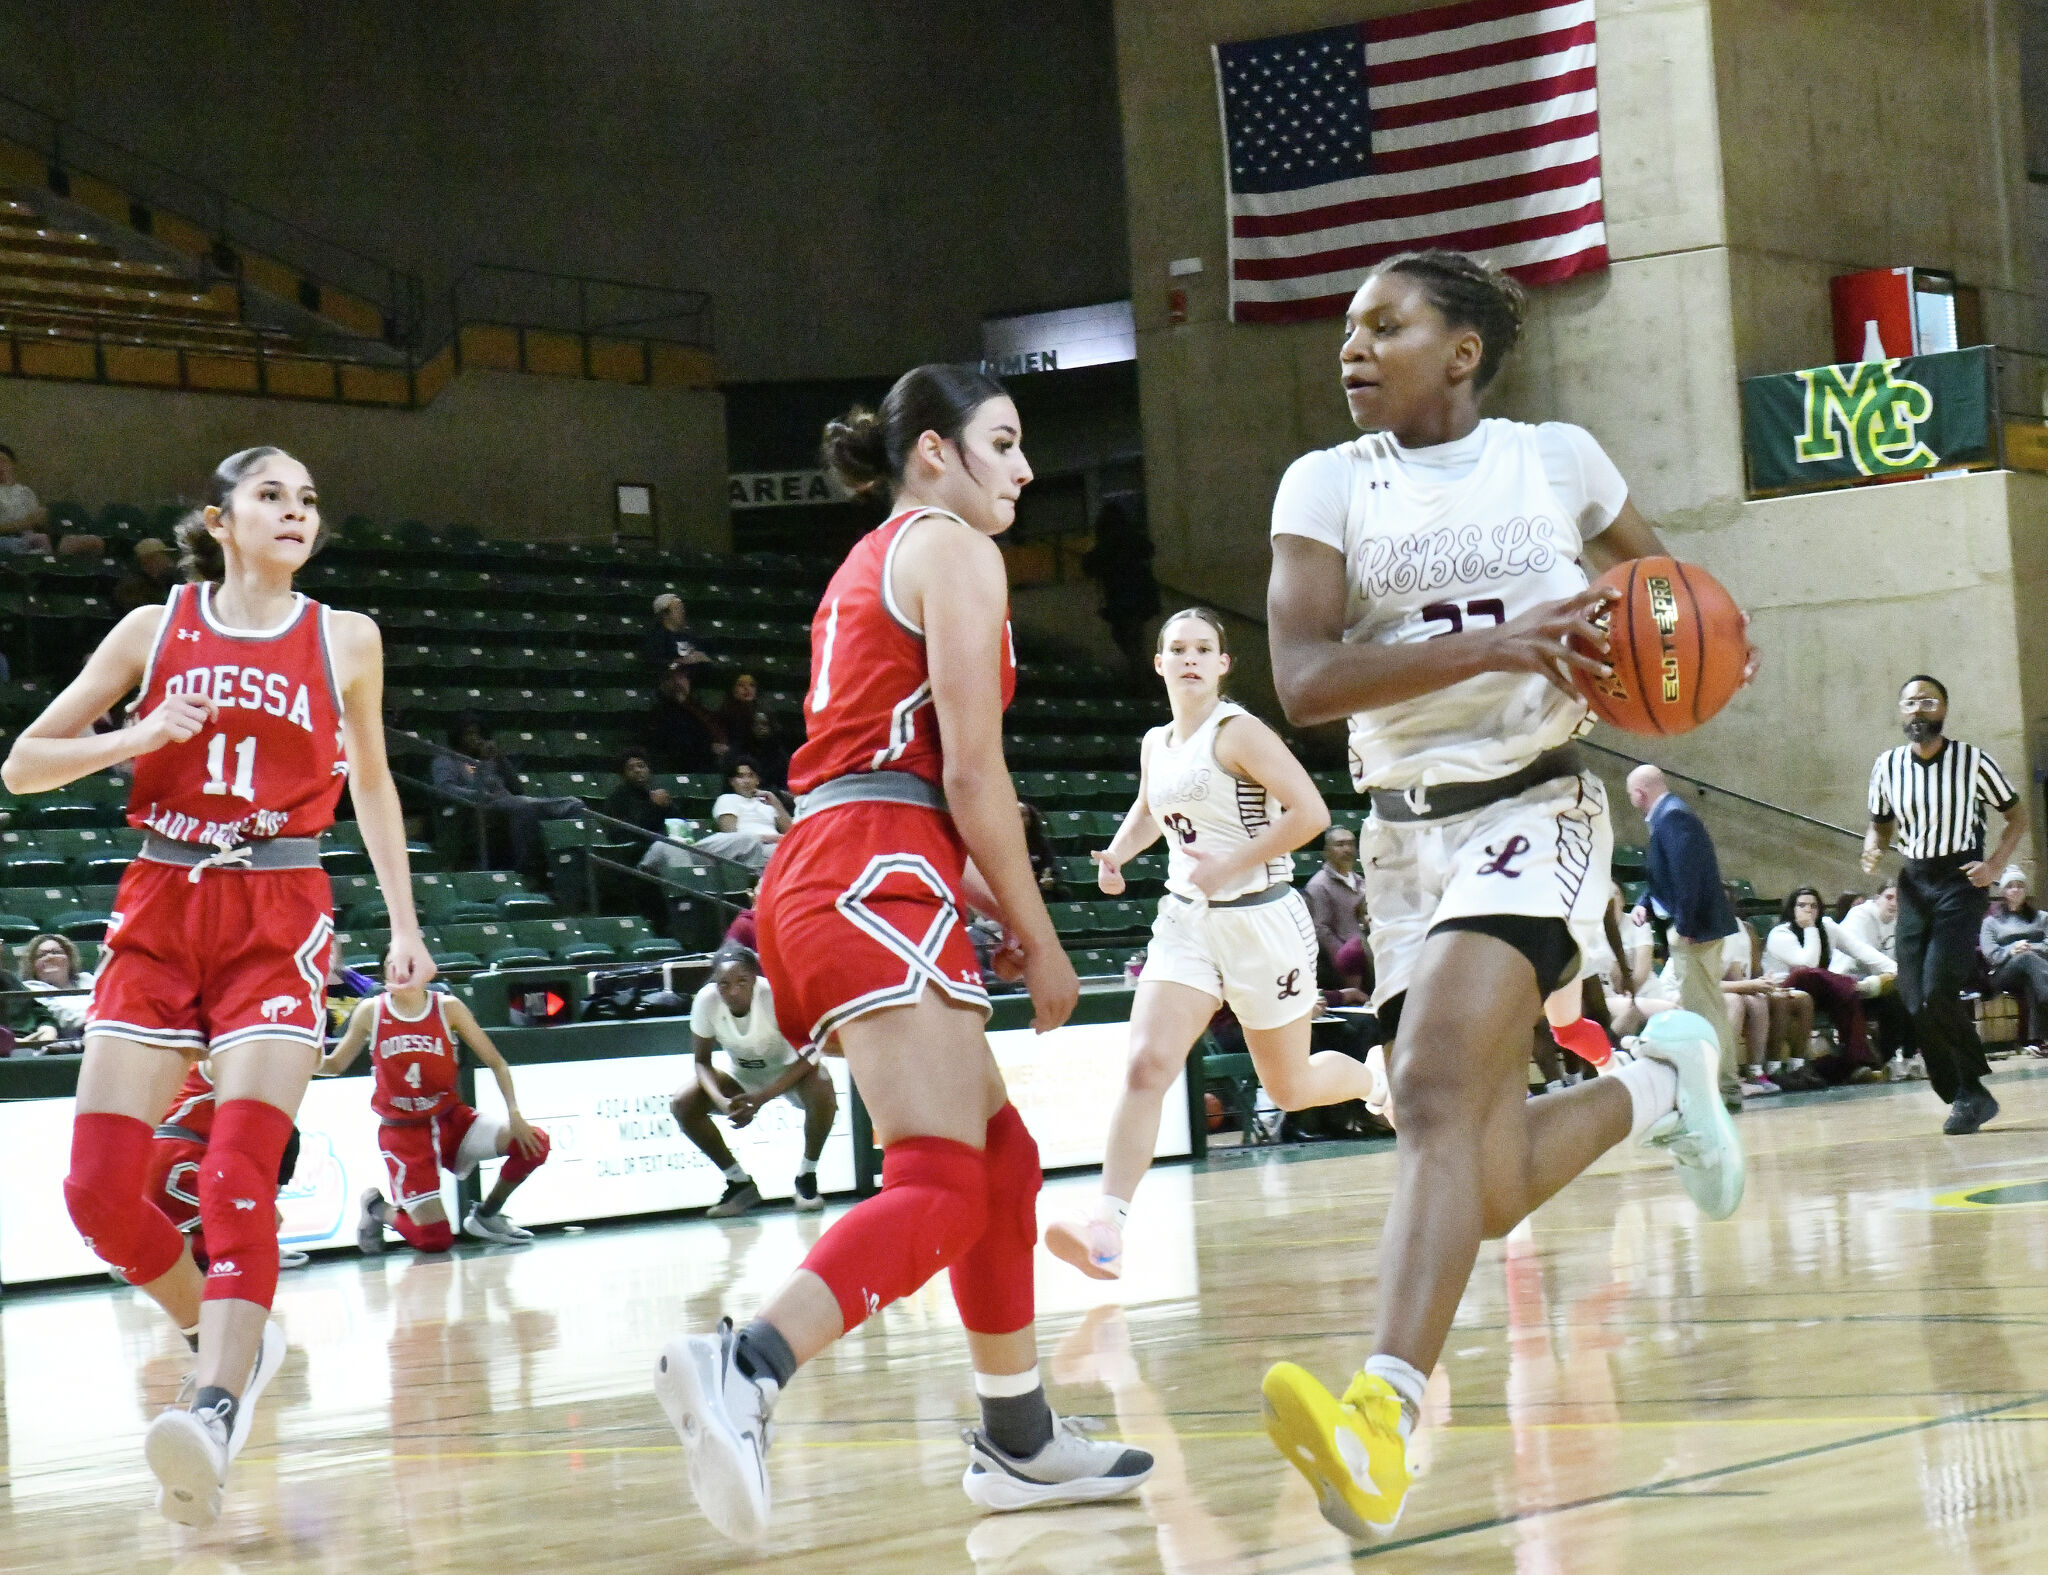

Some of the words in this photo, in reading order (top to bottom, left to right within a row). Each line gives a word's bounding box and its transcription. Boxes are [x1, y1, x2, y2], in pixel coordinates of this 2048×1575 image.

[728, 475, 830, 502] AREA
[1358, 515, 1557, 599] REBELS
[1648, 577, 1677, 616] PRO
[1657, 612, 1680, 703] ELITE
[165, 665, 312, 732] ODESSA
[203, 733, 257, 802] 11
[143, 802, 199, 841] LADY
[380, 1034, 445, 1059] ODESSA
[404, 1062, 421, 1089] 4
